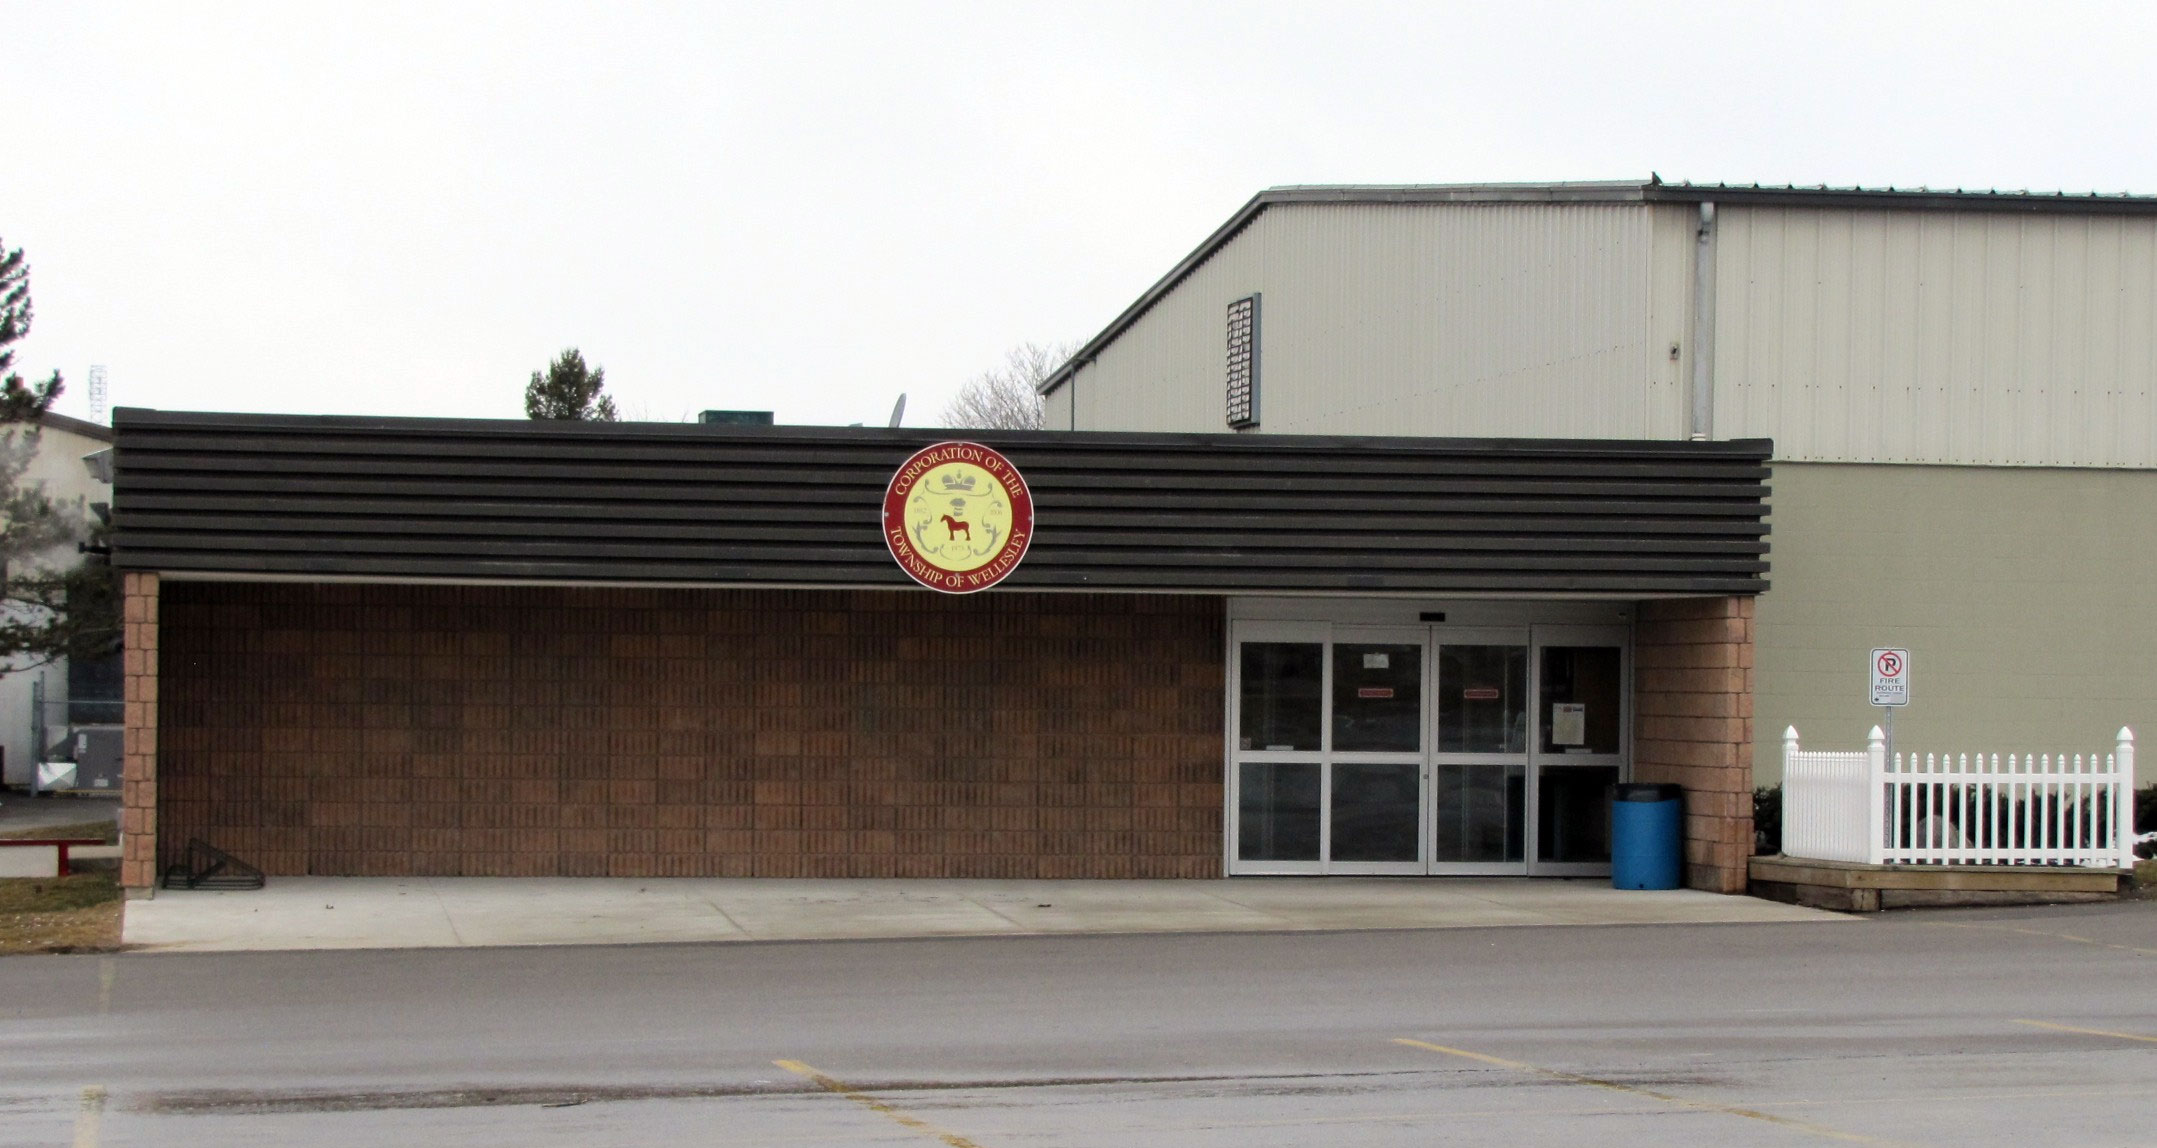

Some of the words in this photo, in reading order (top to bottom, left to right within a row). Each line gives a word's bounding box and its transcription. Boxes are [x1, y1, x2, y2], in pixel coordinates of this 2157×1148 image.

[895, 447, 983, 496] CORPORATION
[985, 456, 1003, 472] OF
[1002, 470, 1023, 498] THE
[891, 526, 943, 583] TOWNSHIP
[945, 575, 965, 587] OF
[967, 529, 1026, 586] WELLESLEY
[1885, 658, 1896, 671] P
